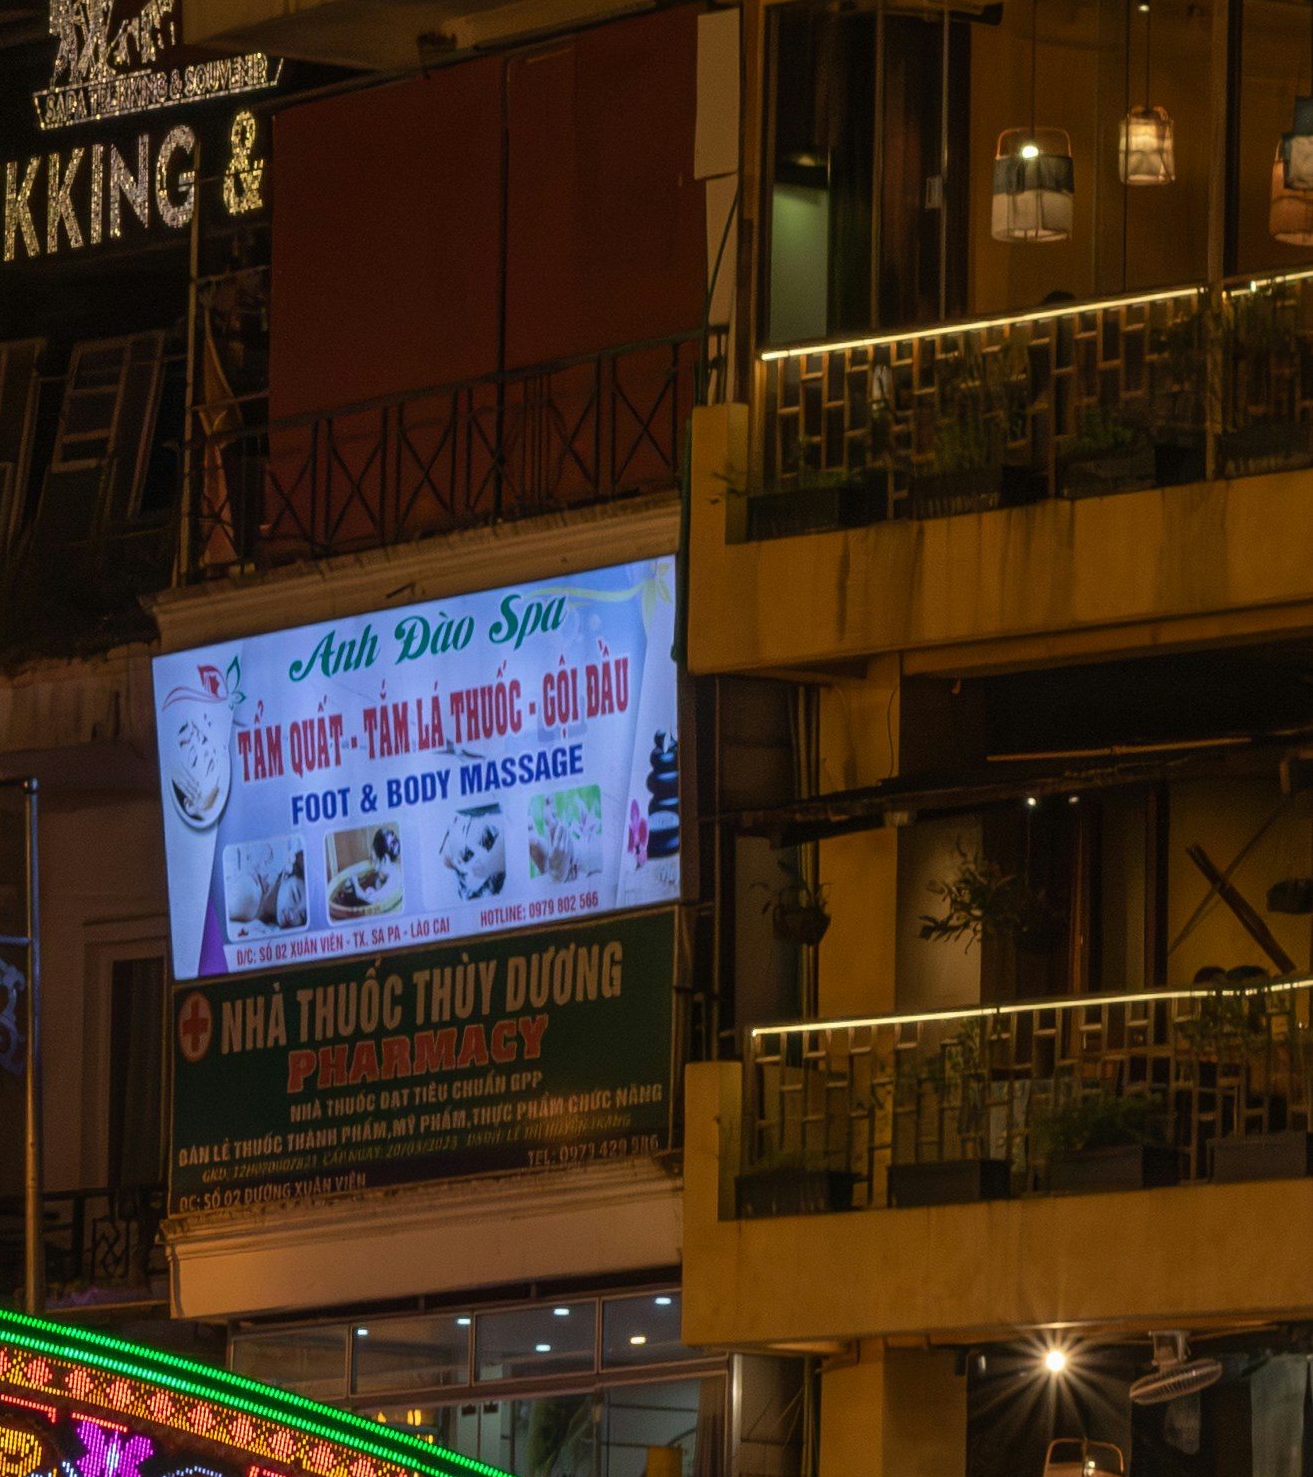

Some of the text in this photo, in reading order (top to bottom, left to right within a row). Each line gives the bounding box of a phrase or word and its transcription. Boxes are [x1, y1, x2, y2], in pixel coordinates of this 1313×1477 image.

[45, 93, 87, 124] SAPA
[88, 71, 168, 116] TREKKING
[222, 110, 266, 217] &
[289, 593, 569, 682] Anh Đào Spa
[289, 695, 344, 775] QUẤT
[416, 681, 446, 753] LÁ
[449, 659, 522, 744] THUỐC
[542, 653, 581, 740] GỘI
[586, 639, 629, 720] ĐẦU
[290, 744, 585, 825] FOOT & BODY MASSAGE
[275, 943, 288, 961] 02
[372, 927, 386, 945] SA
[387, 925, 402, 942] PA
[433, 916, 451, 935] CAI
[479, 891, 599, 928] HOTLINE: 0979 802 566
[221, 940, 624, 1056] NHÀ THUỐC THÙY DƯƠNG
[286, 1013, 550, 1094] PHARMACY
[290, 1098, 323, 1124] NHÀ
[326, 1089, 377, 1117] THUỐC
[224, 1188, 242, 1207] 02
